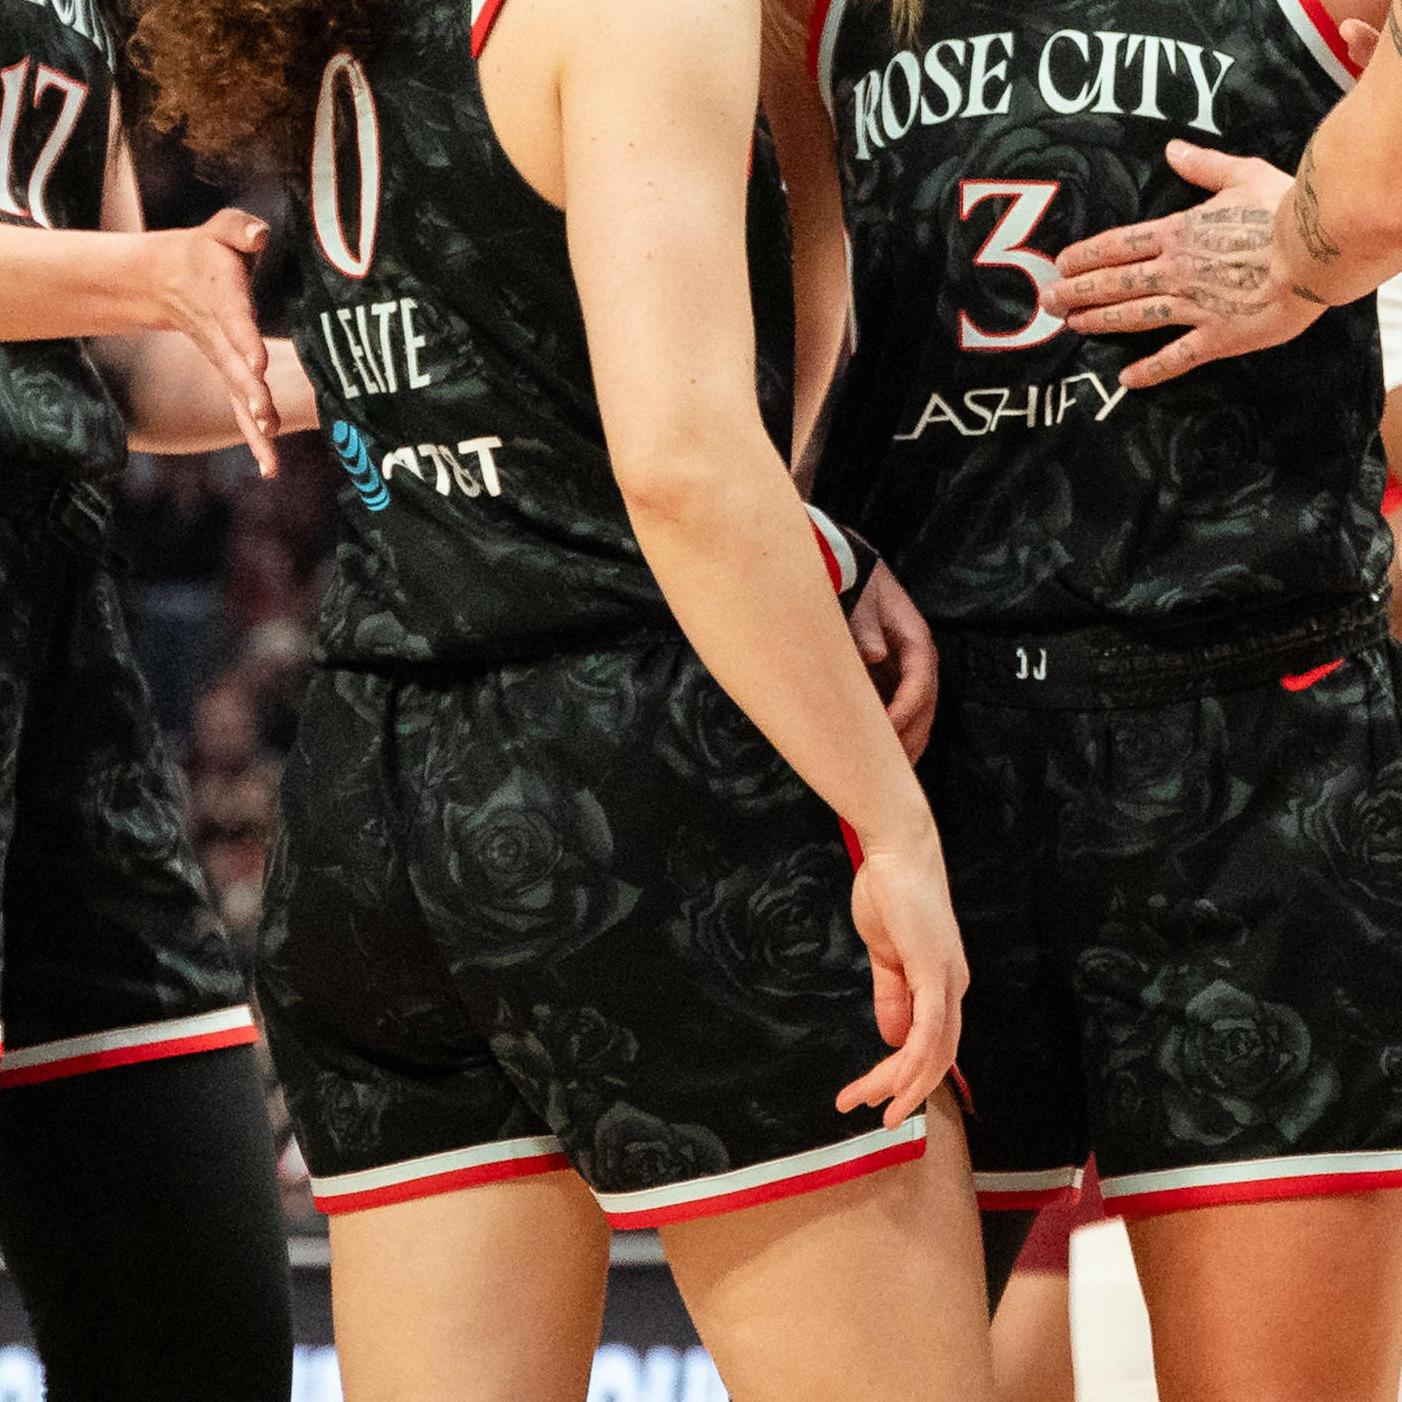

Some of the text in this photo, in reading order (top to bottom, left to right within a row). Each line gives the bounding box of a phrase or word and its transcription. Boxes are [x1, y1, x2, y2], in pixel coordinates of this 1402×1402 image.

[311, 51, 381, 279] 0
[852, 28, 1235, 161] ROSE CITY
[958, 178, 1073, 353] 3
[320, 298, 432, 399] LEITE
